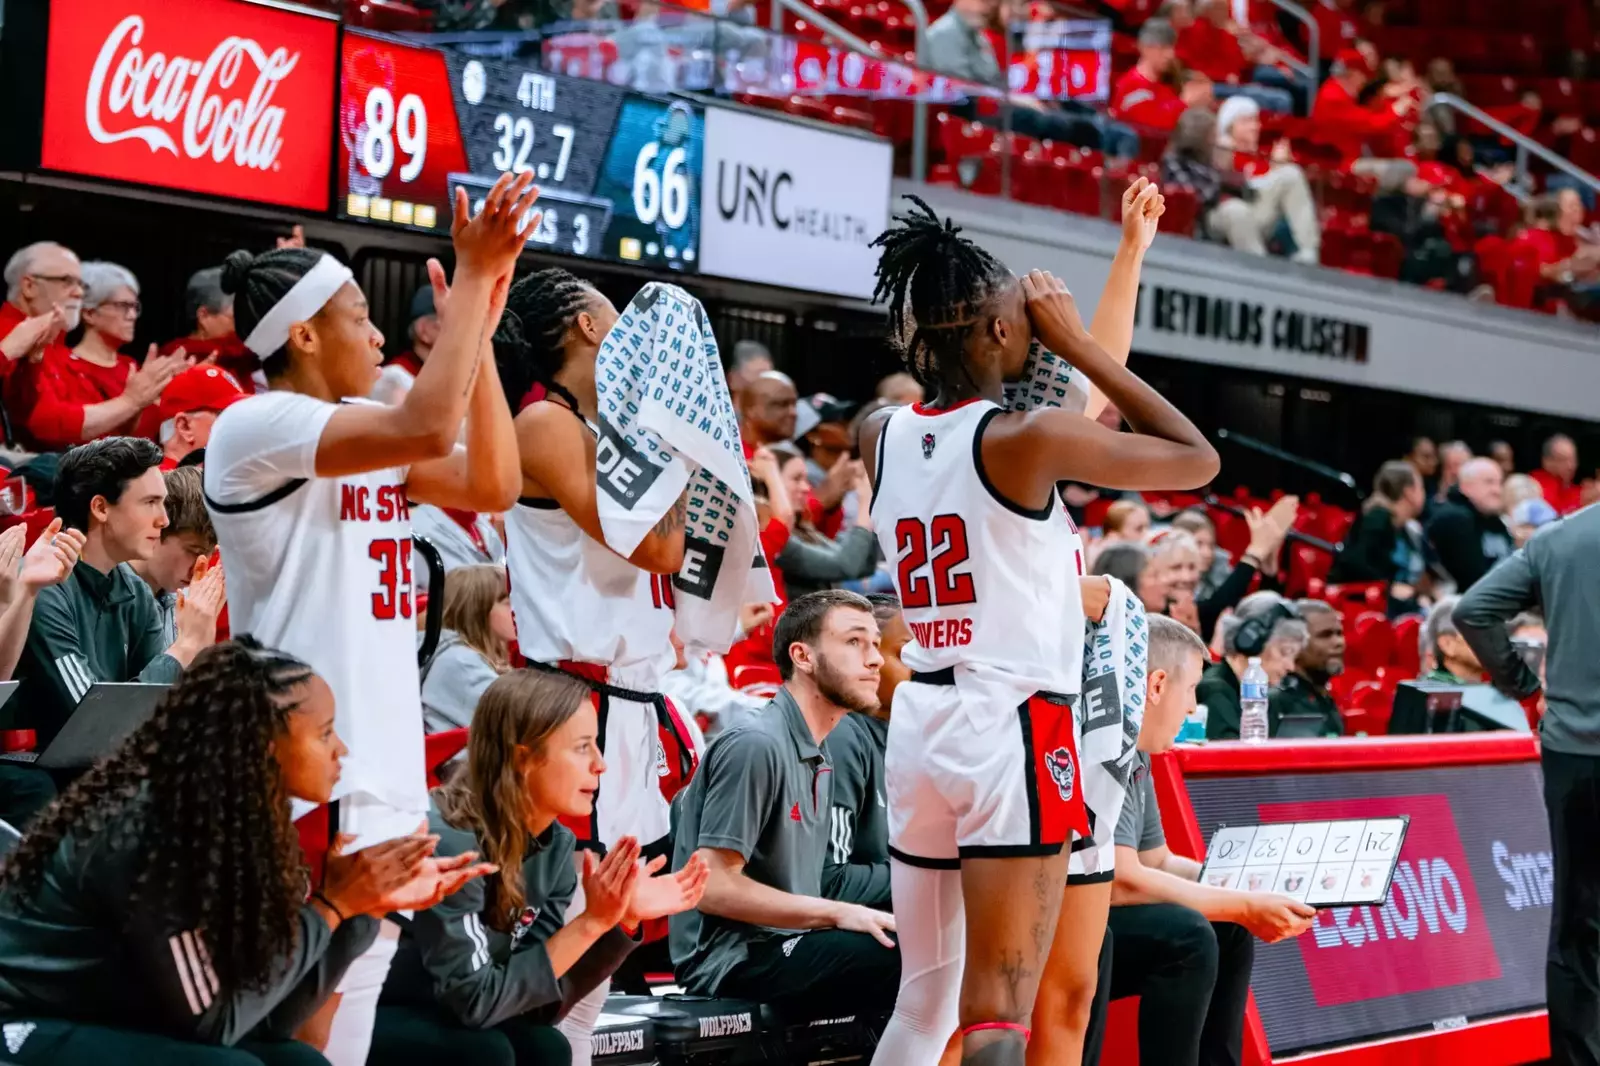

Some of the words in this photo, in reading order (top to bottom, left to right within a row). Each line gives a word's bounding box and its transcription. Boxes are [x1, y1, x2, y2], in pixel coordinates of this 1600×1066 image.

[86, 15, 299, 172] Coca-Cola
[517, 72, 556, 112] 4TH
[363, 87, 428, 183] 89
[493, 113, 574, 182] 32.7
[632, 142, 689, 229] 66
[718, 160, 793, 231] UNC
[1153, 286, 1263, 347] REYNOLDS
[340, 484, 371, 522] NC
[896, 513, 977, 608] 22
[591, 1029, 644, 1056] WOLFPACK
[699, 1012, 752, 1038] WOLFPACK
